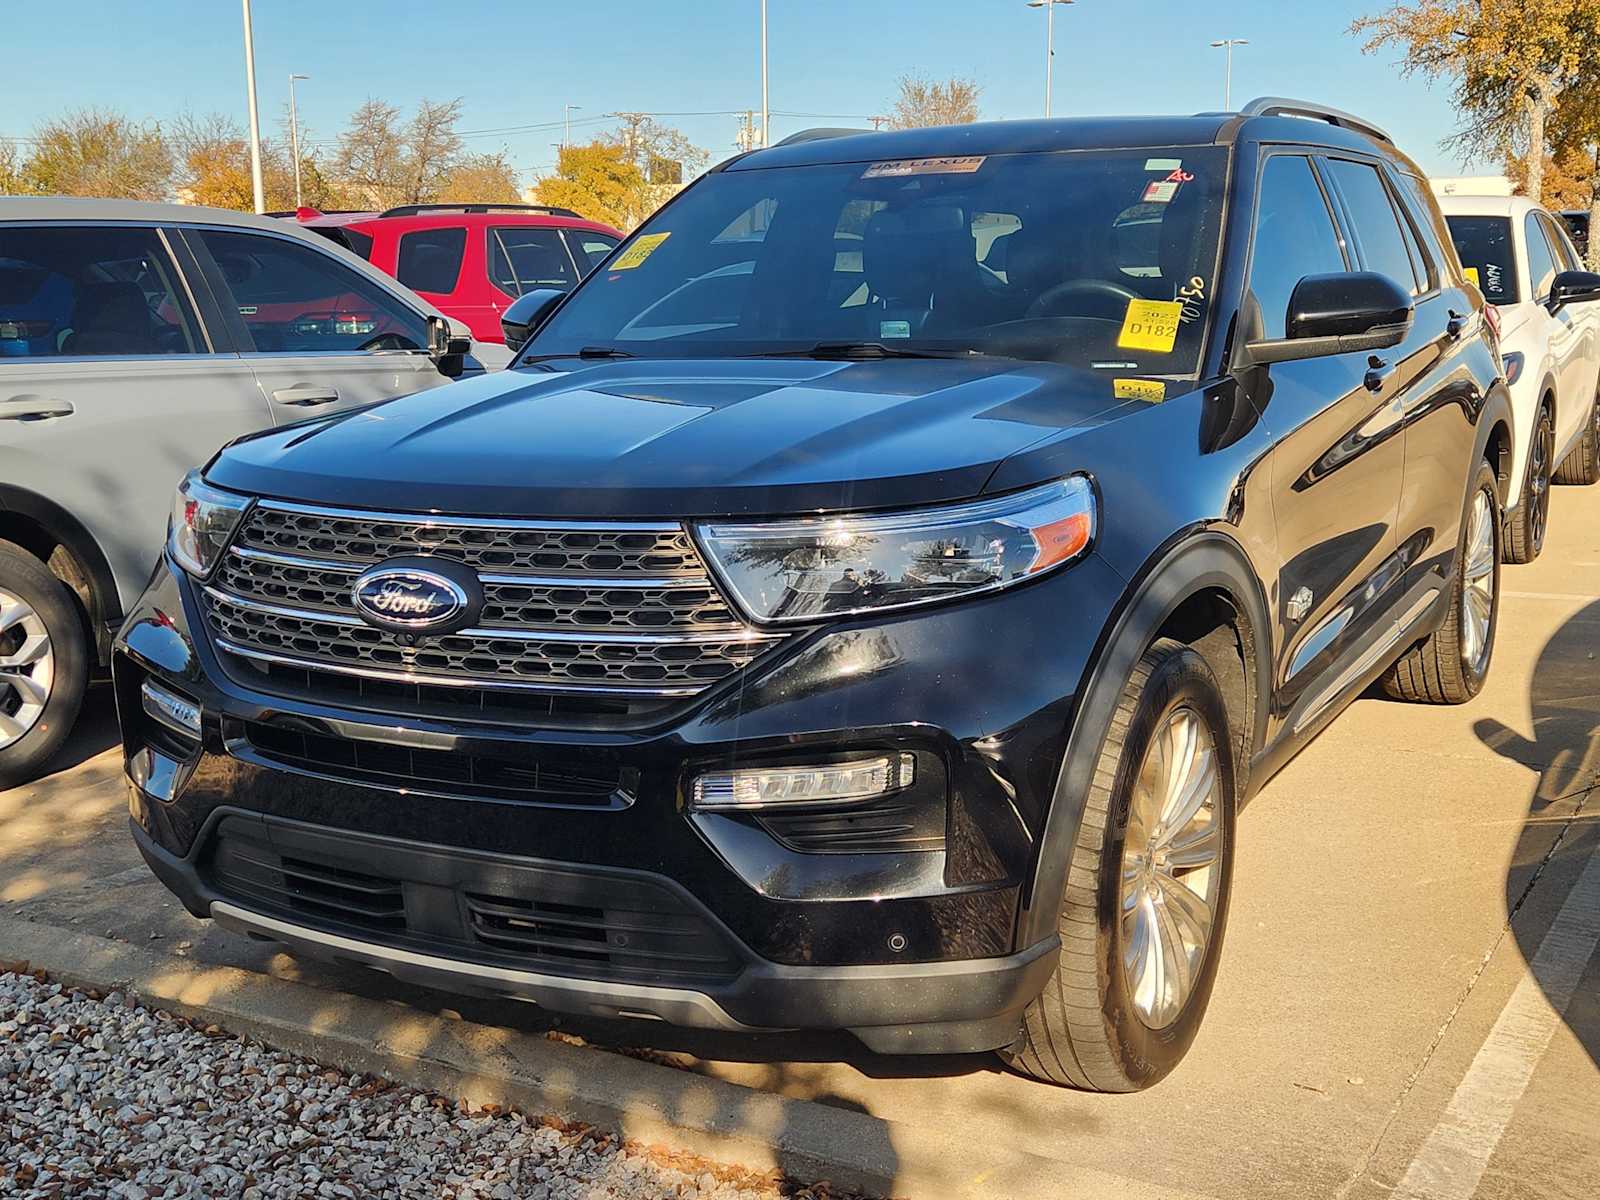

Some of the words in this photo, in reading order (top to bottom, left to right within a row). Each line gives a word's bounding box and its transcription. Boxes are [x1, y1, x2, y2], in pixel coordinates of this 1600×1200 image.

[910, 158, 984, 168] LEXUS
[1129, 322, 1177, 338] D182
[367, 579, 440, 614] Ford
